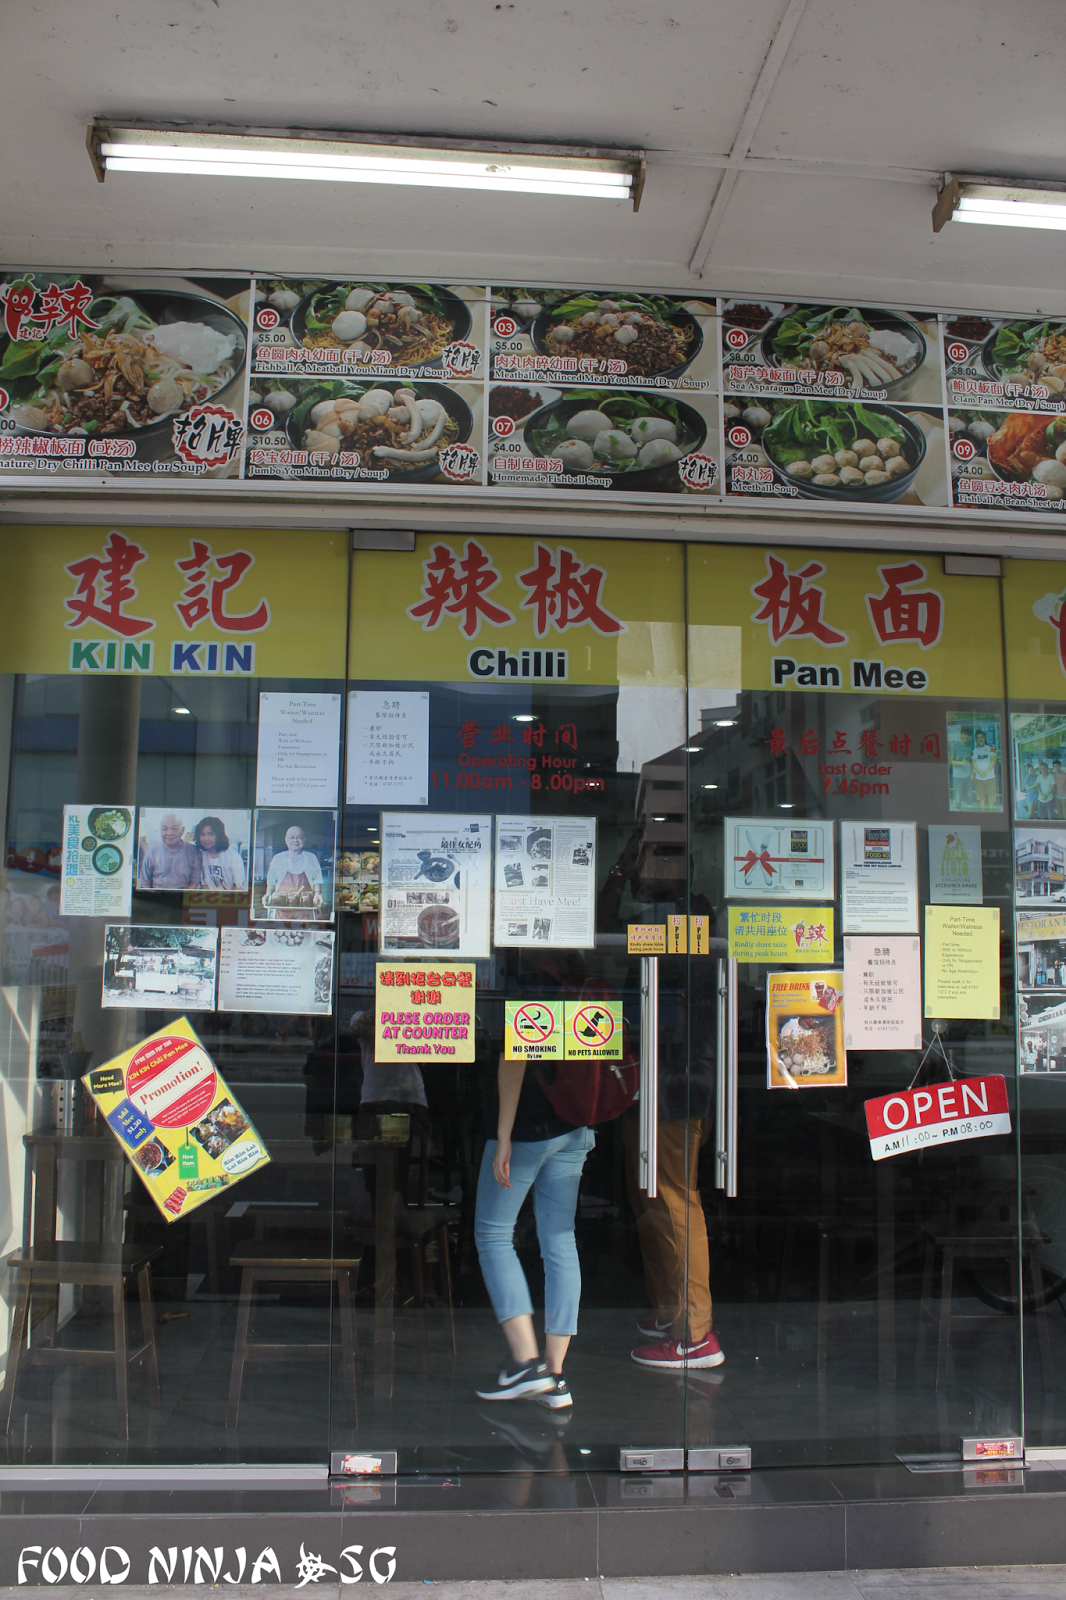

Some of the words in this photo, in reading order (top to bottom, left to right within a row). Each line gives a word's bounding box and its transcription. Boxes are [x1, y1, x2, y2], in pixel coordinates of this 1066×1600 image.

[260, 314, 276, 325] 02
[498, 322, 513, 333] 03
[258, 333, 286, 343] $5.00
[730, 333, 745, 345] 04
[495, 341, 523, 351] $5.00
[729, 353, 756, 363] $8.00
[951, 348, 965, 358] 05
[256, 363, 294, 373] Fishball
[306, 364, 348, 374] Meatball
[349, 365, 369, 374] You
[371, 366, 396, 375] Mian
[425, 368, 453, 379] Soup)
[951, 366, 977, 376] $8.00
[494, 370, 535, 380] Meatball
[548, 372, 583, 382] Minced
[585, 374, 608, 384] Meat
[609, 375, 629, 384] You
[629, 376, 653, 386] Mian
[683, 379, 710, 390] Soup)
[730, 381, 746, 390] Sea
[748, 383, 795, 395] Asparagus
[795, 384, 812, 394] Pan
[813, 385, 834, 395] Mee
[861, 388, 888, 400] Soup)
[953, 394, 976, 404] Clam
[978, 395, 995, 405] Pan
[996, 397, 1014, 407] Mee
[254, 414, 271, 426] 06
[496, 421, 512, 432] 07
[252, 435, 287, 446] $10.50
[732, 431, 748, 443] 08
[493, 442, 522, 453] $4.00
[957, 444, 971, 455] 09
[732, 452, 759, 463] $4.00
[37, 459, 60, 473] Dry
[63, 460, 97, 471] Chilli
[100, 460, 122, 471] Pan
[124, 460, 151, 472] Mee
[173, 461, 208, 475] Soup)
[957, 465, 984, 476] $4.00
[249, 466, 281, 477] Jumbo
[284, 467, 305, 477] You
[305, 467, 333, 477] Mian
[361, 469, 390, 481] Soup)
[493, 473, 547, 484] Homemade
[548, 474, 587, 485] Fishball
[588, 476, 613, 488] Soup
[774, 484, 799, 496] Soup
[958, 494, 994, 505] Fishball
[1005, 497, 1026, 506] Bean
[1027, 498, 1051, 508] Sheet
[65, 531, 269, 638] 建記
[409, 540, 626, 638] 辣椒
[752, 554, 942, 648] 板面
[71, 641, 151, 670] KIN
[172, 642, 253, 672] KIN
[468, 648, 567, 679] Chilli
[773, 658, 841, 687] Pan
[852, 661, 928, 690] Mee
[457, 718, 578, 751] 营业时间
[458, 753, 538, 772] Operating
[541, 754, 579, 769] Hour
[819, 761, 850, 776] Last
[851, 762, 893, 776] Order
[431, 772, 514, 790] 11.00am
[821, 778, 890, 799] 7.45pm
[69, 814, 80, 823] KL
[734, 940, 755, 950] Kindly
[755, 941, 772, 949] share
[772, 941, 788, 949] table
[732, 950, 754, 959] during
[754, 951, 770, 959] peak
[771, 982, 789, 992] FREE
[789, 982, 811, 991] DRINK
[381, 1011, 420, 1026] PLESE
[423, 1012, 470, 1026] ORDER
[382, 1027, 401, 1039] AT
[402, 1027, 468, 1040] COUNTER
[395, 1043, 431, 1055] Thank
[432, 1044, 455, 1056] You
[512, 1045, 523, 1053] NO
[523, 1045, 557, 1054] SMOKING
[567, 1049, 577, 1057] NO
[577, 1049, 592, 1057] PETS
[592, 1048, 620, 1057] ALLOWED
[100, 1074, 115, 1082] Need
[139, 1060, 204, 1106] Promotion!
[93, 1081, 108, 1090] More
[108, 1079, 123, 1088] Mee?
[882, 1081, 989, 1131] OPEN
